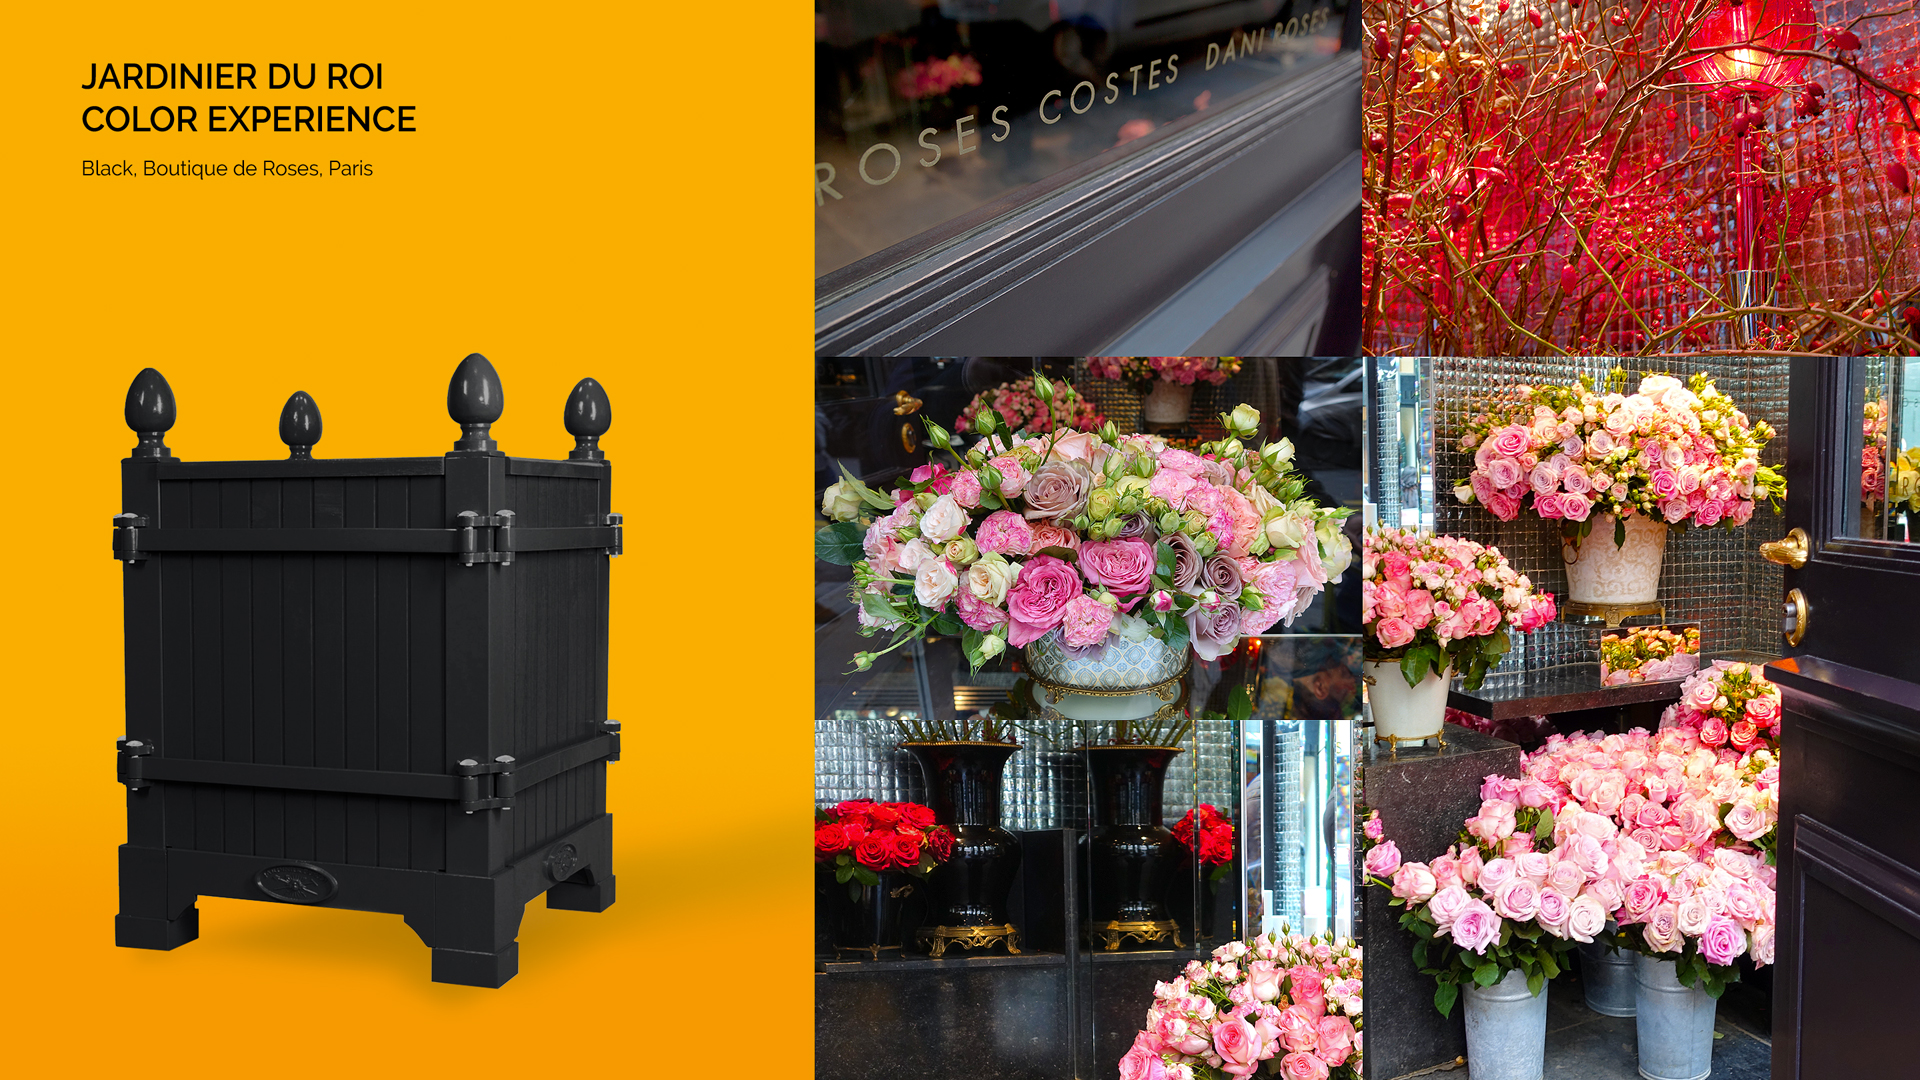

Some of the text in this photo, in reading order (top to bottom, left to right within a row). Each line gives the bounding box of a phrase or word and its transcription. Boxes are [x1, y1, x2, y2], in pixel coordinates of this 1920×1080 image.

[1205, 7, 1330, 71] DANI ROSES
[815, 54, 1179, 207] ROSES COSTES
